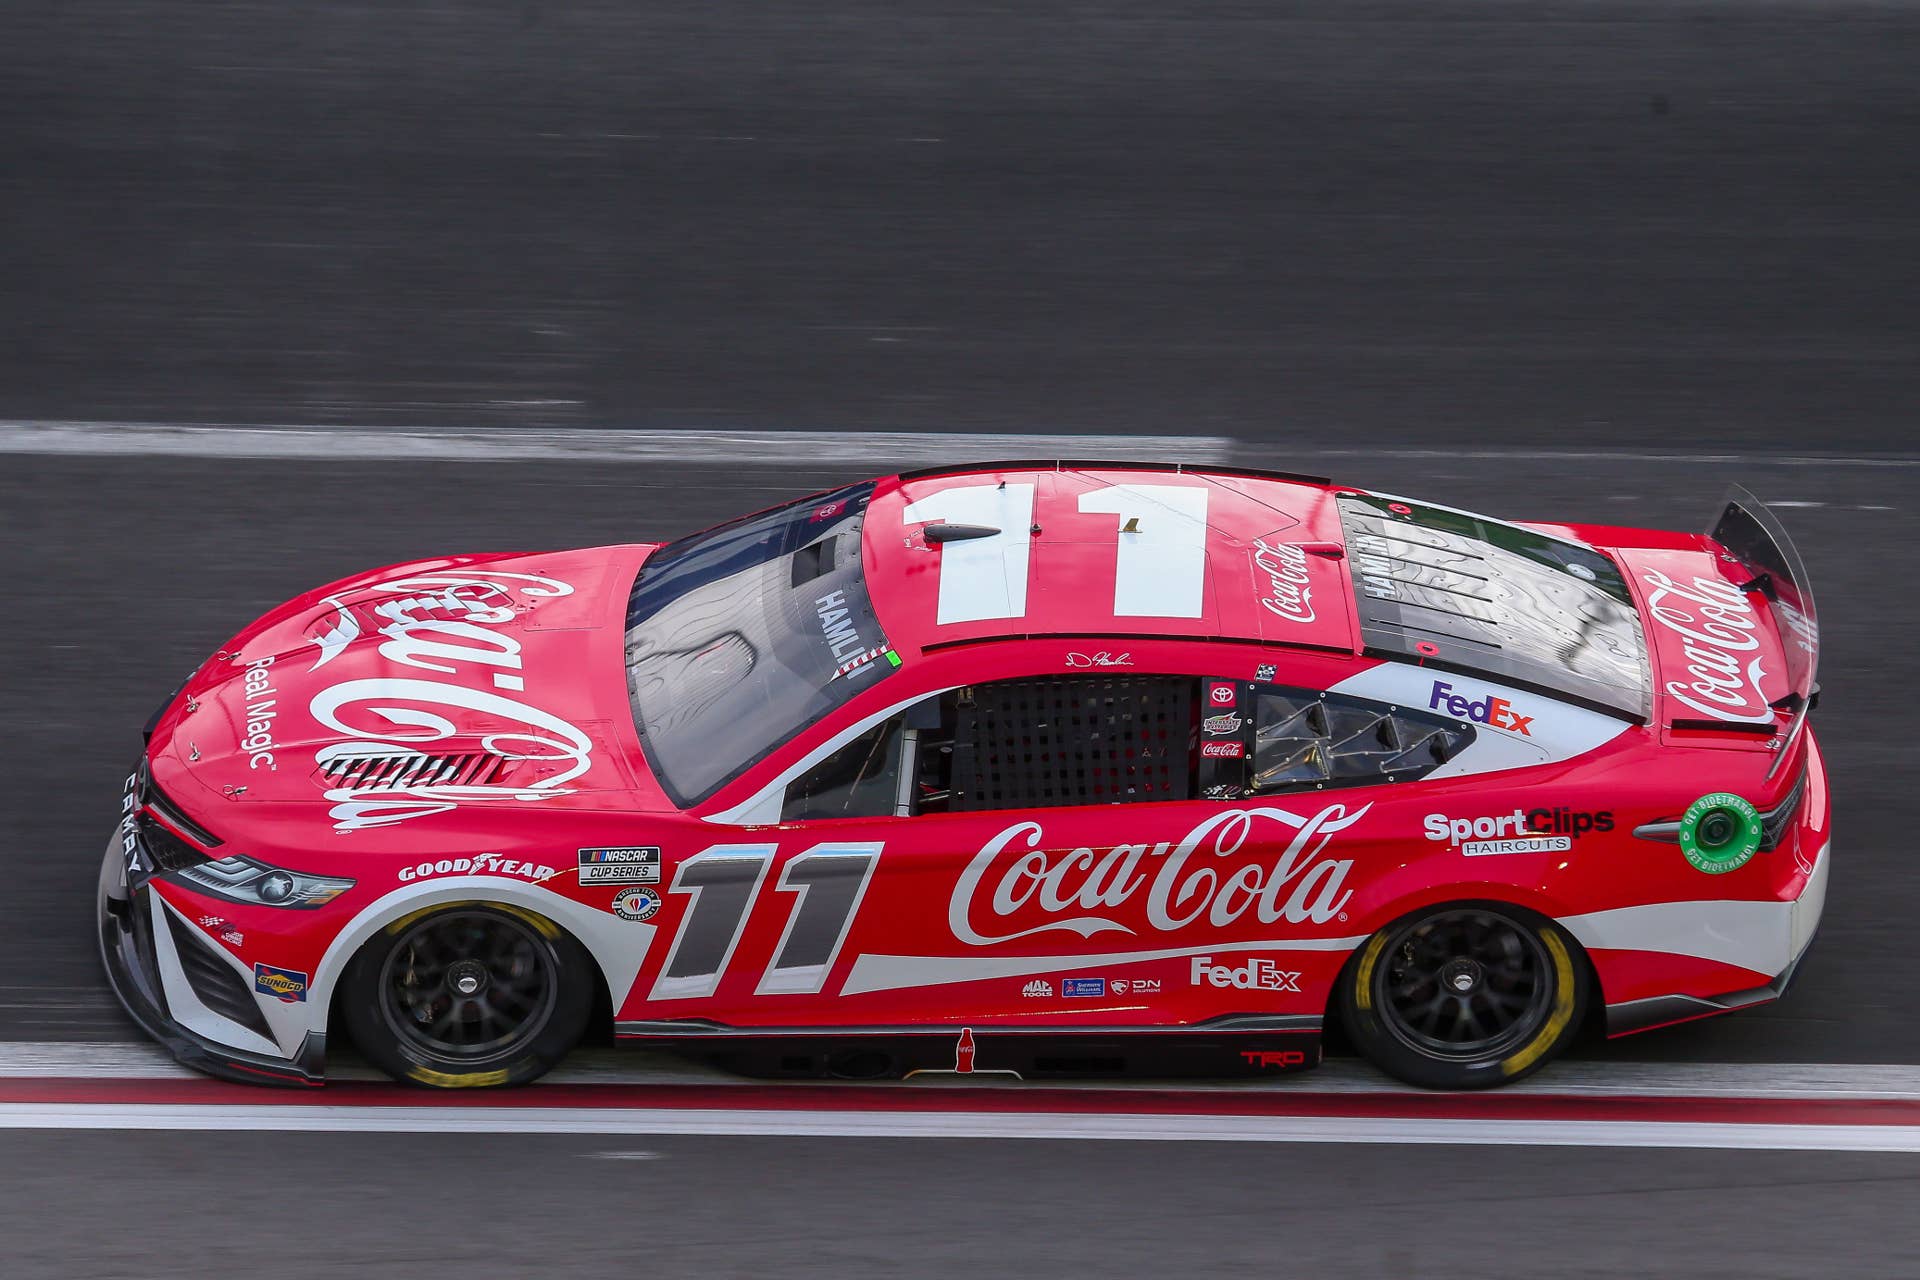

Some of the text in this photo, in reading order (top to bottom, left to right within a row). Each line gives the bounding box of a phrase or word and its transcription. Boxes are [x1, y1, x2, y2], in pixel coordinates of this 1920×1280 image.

[903, 482, 1209, 626] 11
[1640, 565, 1775, 724] Coca-Cola
[241, 656, 280, 769] Real Magic
[1429, 680, 1535, 737] FedEx
[1684, 808, 1700, 825] GET
[1466, 838, 1568, 854] HAIRCUTS
[604, 850, 648, 862] NASCAR
[1687, 848, 1702, 865] GET
[590, 866, 649, 878] CUP SERIES
[948, 801, 1374, 946] Coca-Cola
[646, 841, 886, 1001] 11
[1190, 956, 1302, 992] FedEx
[259, 976, 304, 991] SUNOCO
[1022, 980, 1053, 993] MAC
[1132, 979, 1161, 989] DN
[1240, 1051, 1305, 1068] TRD
